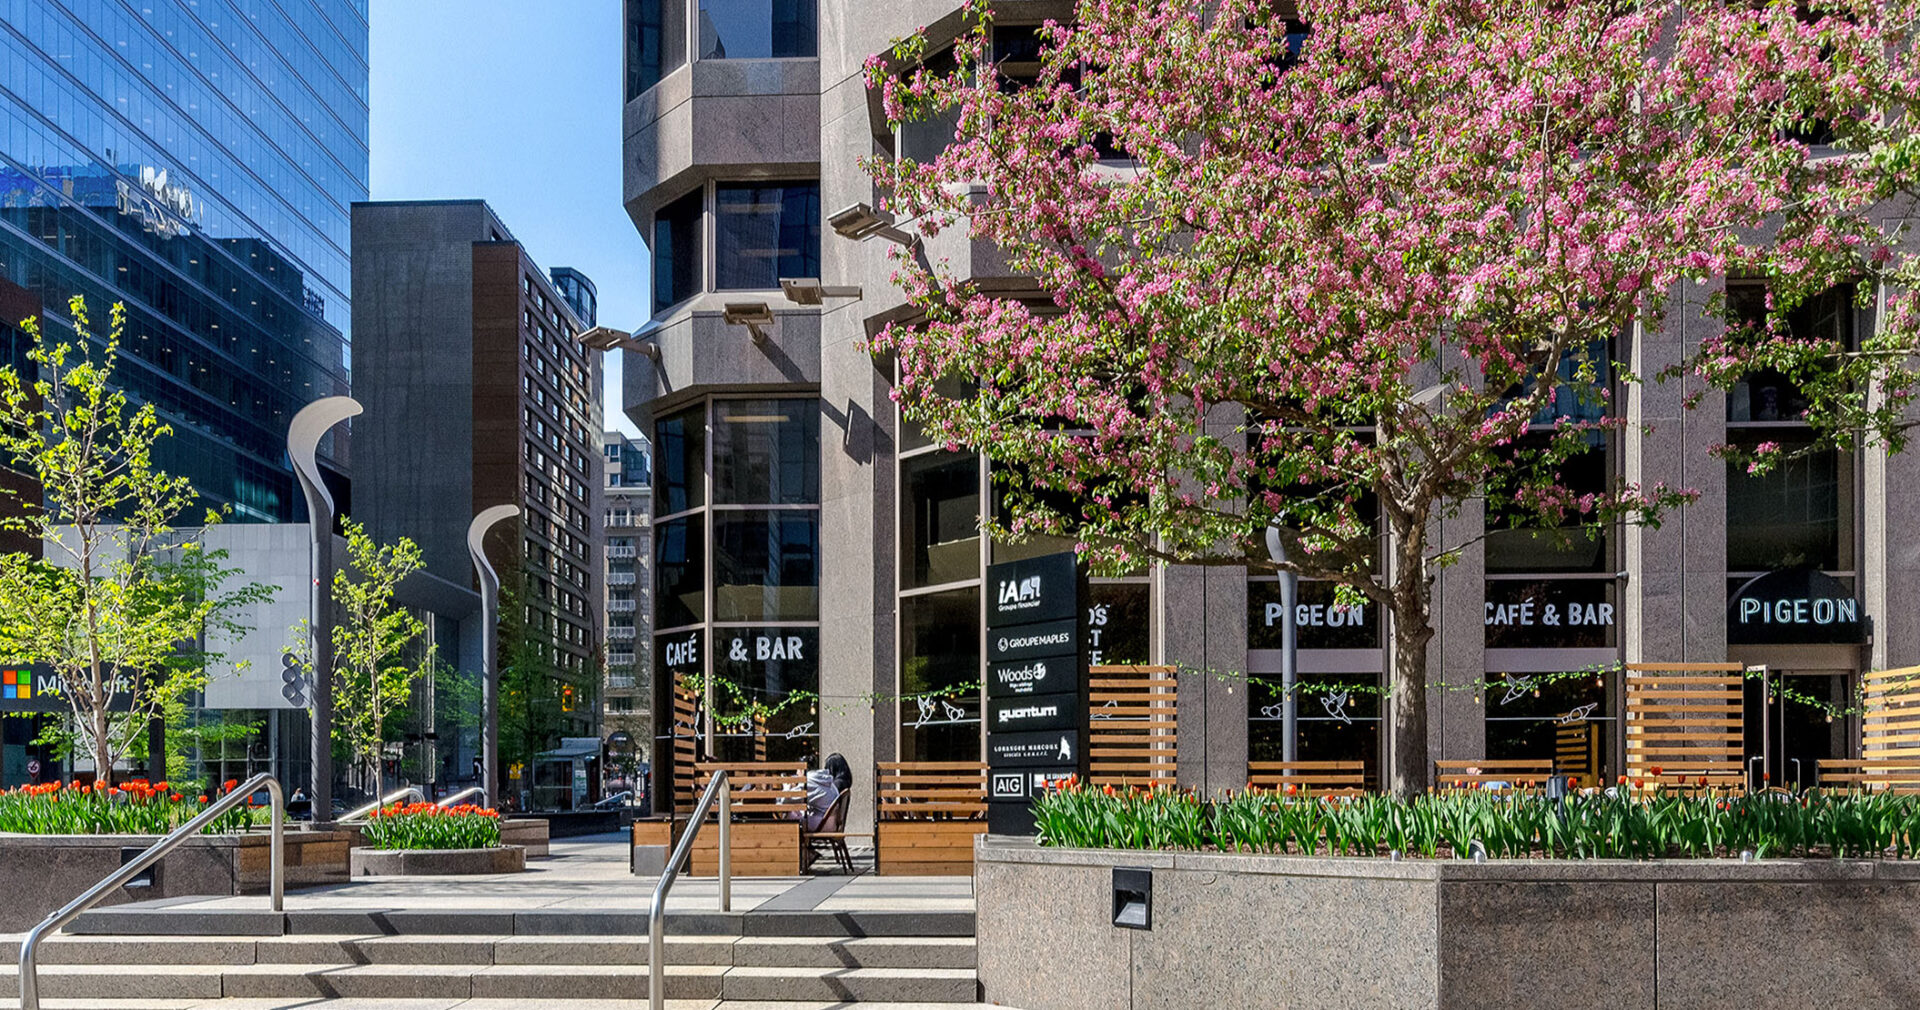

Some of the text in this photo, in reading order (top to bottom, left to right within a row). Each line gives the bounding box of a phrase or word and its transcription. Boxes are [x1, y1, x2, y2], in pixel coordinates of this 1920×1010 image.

[1265, 603, 1363, 627] PGEON
[1485, 597, 1614, 625] CAFÉ & BAR
[1740, 598, 1856, 624] PIGEON
[666, 633, 803, 666] CAFÉ & BAR
[998, 665, 1033, 683] Woods
[999, 706, 1057, 722] quantum
[997, 778, 1020, 792] AIG
